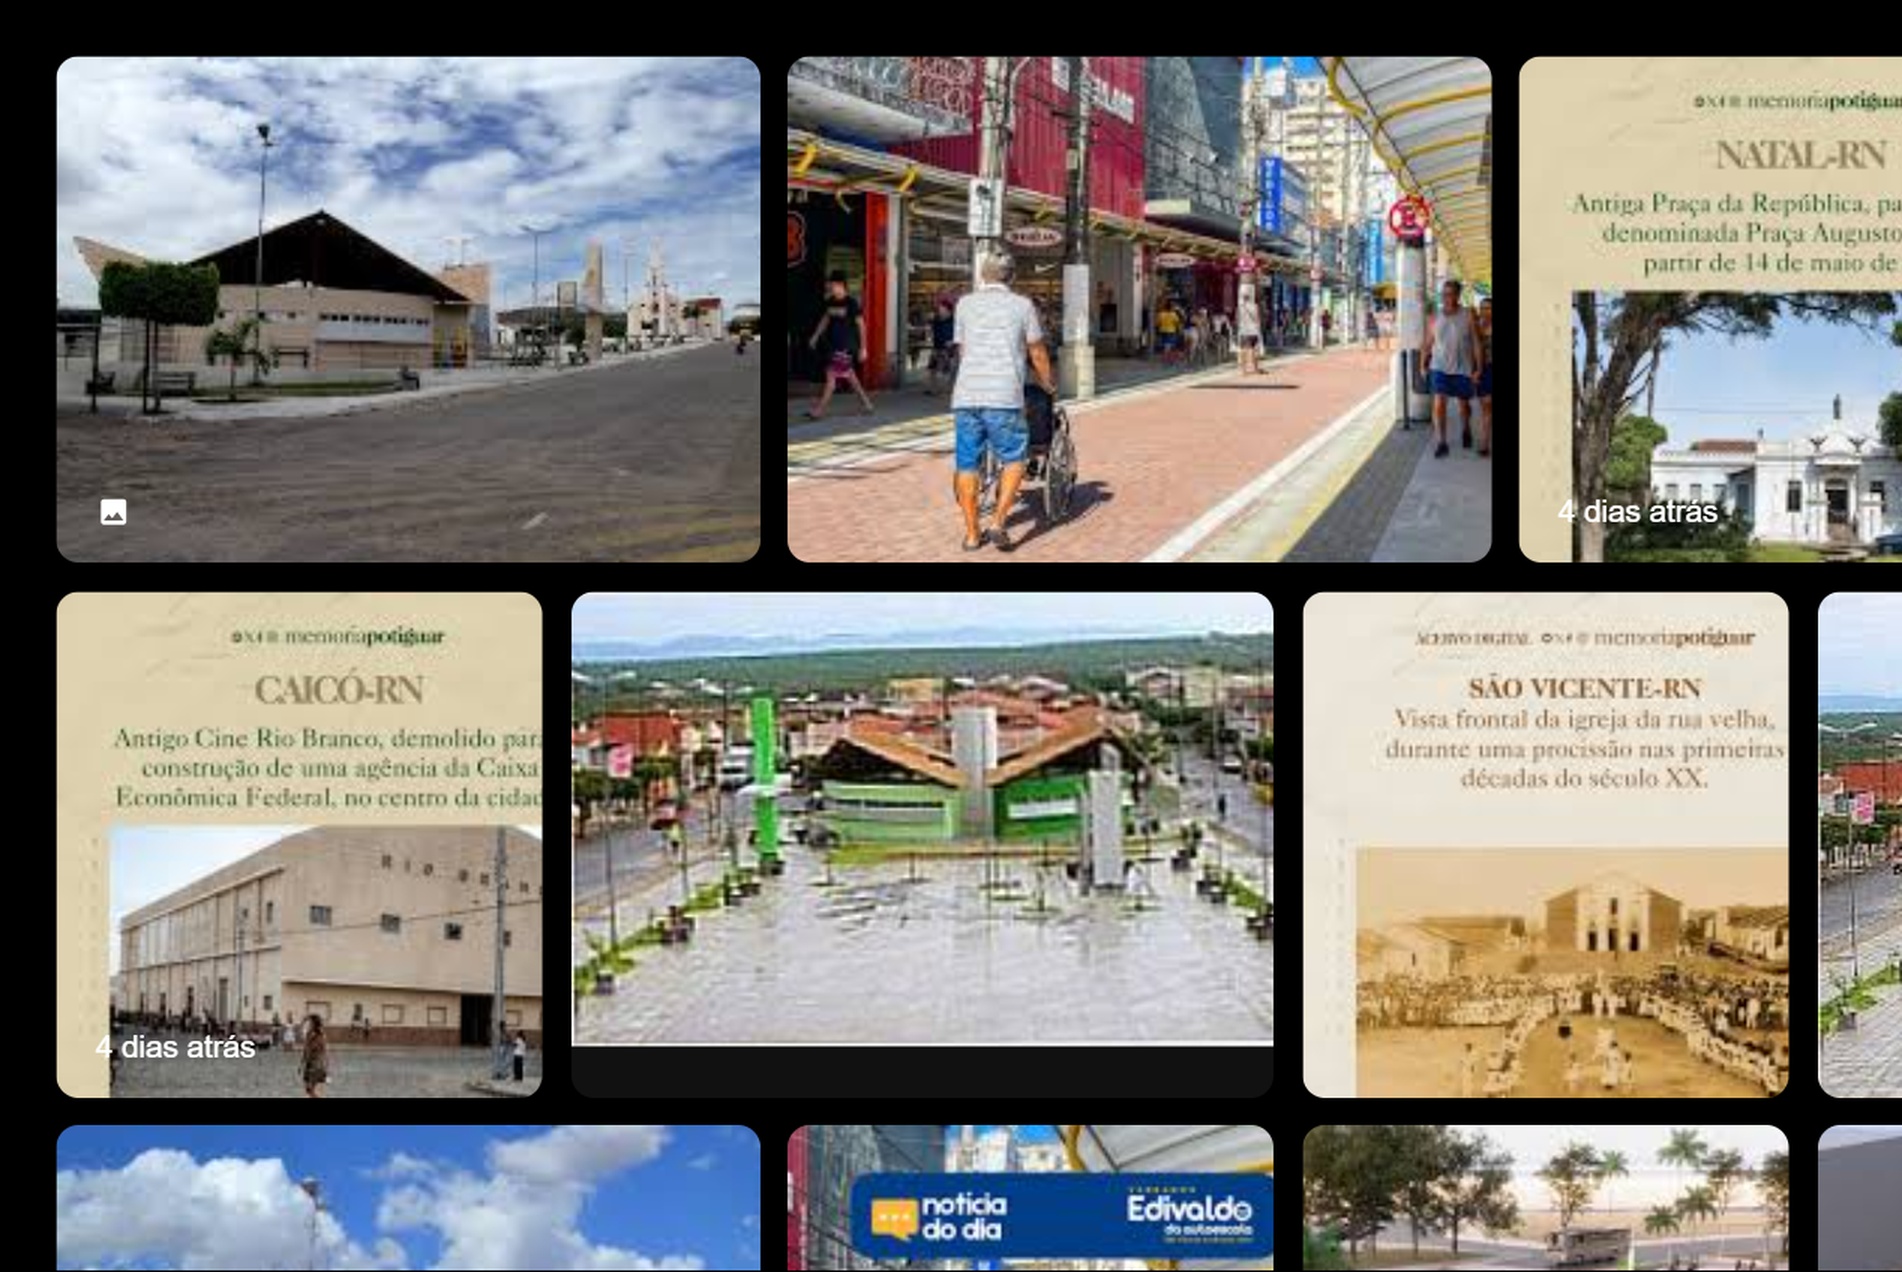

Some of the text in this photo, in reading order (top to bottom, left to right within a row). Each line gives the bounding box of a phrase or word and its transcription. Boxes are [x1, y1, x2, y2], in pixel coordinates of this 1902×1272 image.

[1717, 139, 1887, 170] NATAL-RN
[1573, 193, 1644, 216] Antiga
[1653, 192, 1711, 217] Praça
[1718, 193, 1744, 213] da
[1752, 192, 1870, 217] República,
[1602, 221, 1902, 248] denominada Praça Augusto
[1644, 252, 1898, 277] partir de 14 de maio de
[255, 667, 424, 705] CAICÓ-RN
[1468, 672, 1702, 700] SÃO VICENTE-RN
[1395, 708, 1776, 734] Vista frontal da igreja da rua velha,
[114, 728, 189, 753] Antigo
[195, 728, 248, 749] Cine
[257, 728, 296, 749] Rio
[303, 727, 384, 752] Branco,
[391, 728, 496, 750] demolido
[1386, 737, 1785, 764] durante uma procissão nas primeiras
[142, 757, 540, 783] construção de uma agência da Caixa
[1461, 766, 1709, 789] décadas do século XX.
[117, 785, 238, 808] Econômica
[247, 786, 337, 810] Federal,
[345, 793, 371, 808] no
[378, 791, 448, 808] centro
[455, 786, 480, 808] da
[1127, 1194, 1253, 1222] Edivaldo
[922, 1218, 1002, 1241] do dia
